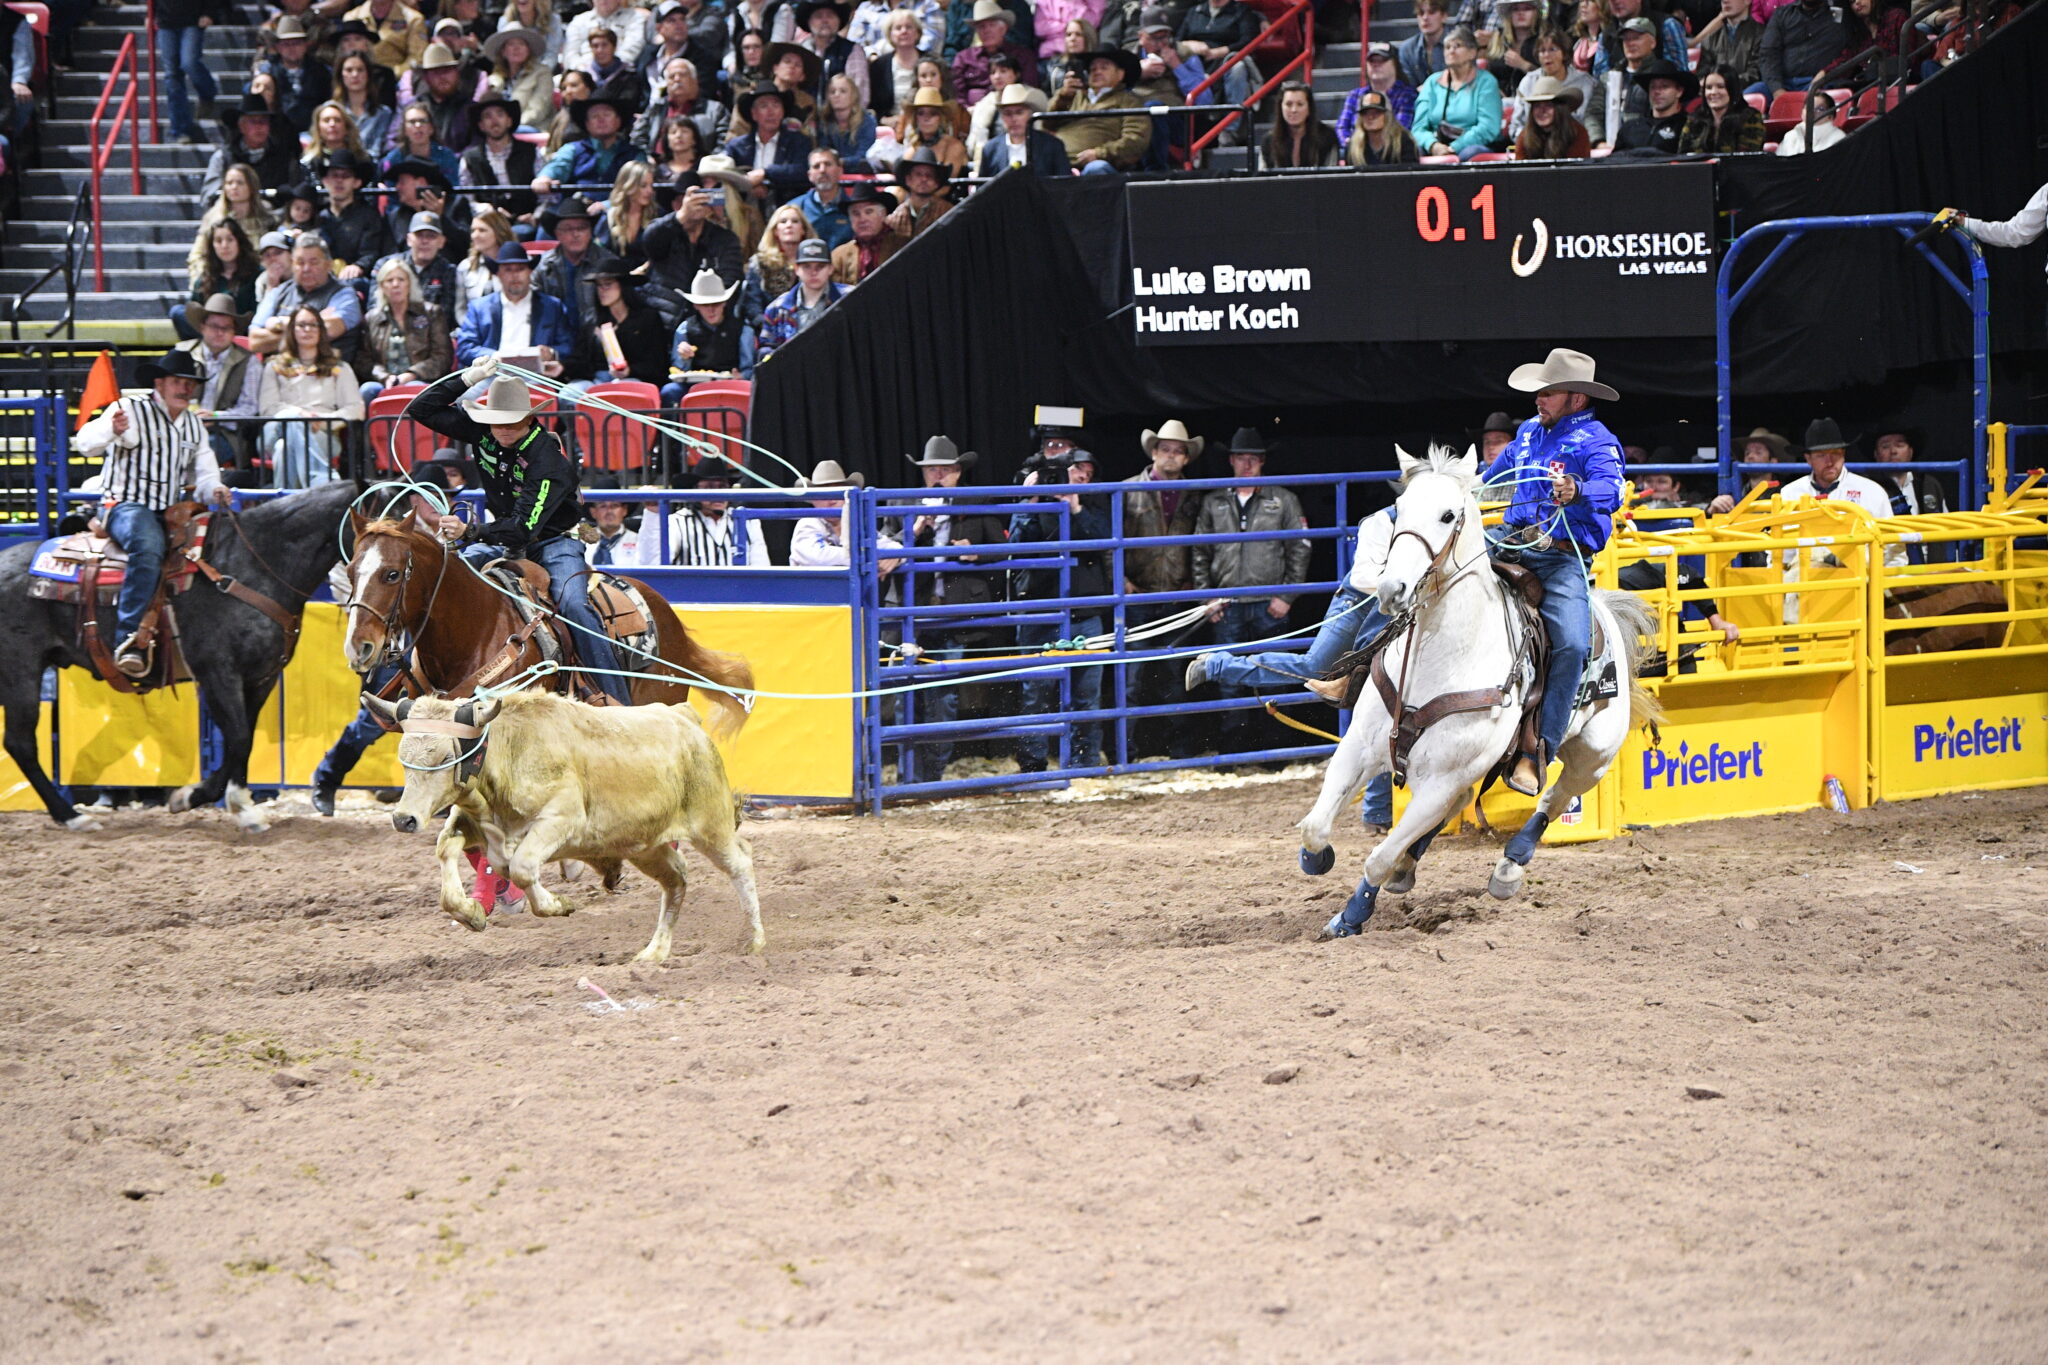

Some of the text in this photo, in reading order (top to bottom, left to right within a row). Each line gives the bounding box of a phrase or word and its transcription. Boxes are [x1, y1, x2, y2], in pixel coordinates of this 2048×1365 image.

[1416, 184, 1495, 242] 0.1
[1133, 264, 1311, 296] Luke Brown
[1619, 261, 1707, 275] LAS VEGAS
[1135, 302, 1299, 332] Hunter Koch
[519, 426, 542, 451] CINCH
[525, 479, 551, 530] CINCH
[1913, 715, 2022, 762] Priefert
[1642, 739, 1763, 789] Priefert
